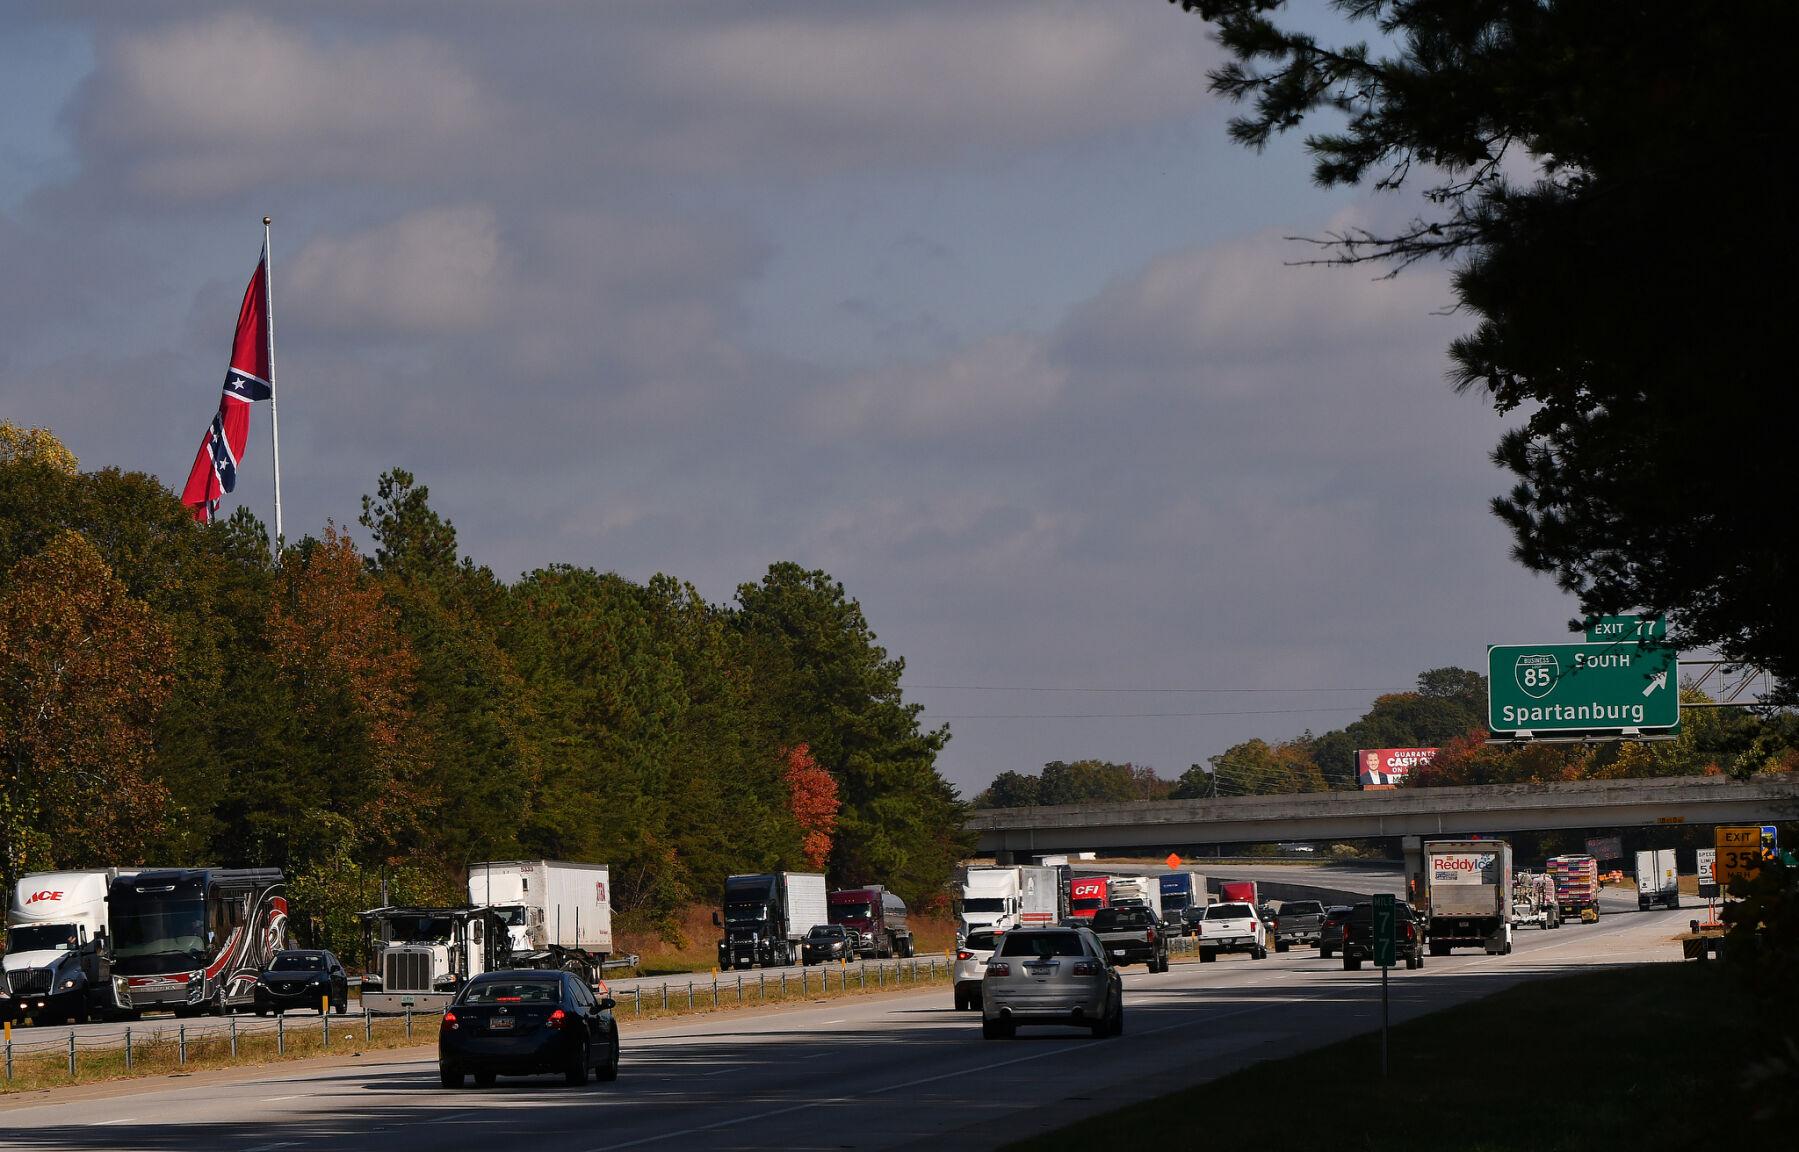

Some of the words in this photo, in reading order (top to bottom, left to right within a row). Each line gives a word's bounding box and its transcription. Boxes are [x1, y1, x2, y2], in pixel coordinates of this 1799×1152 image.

[1595, 623, 1624, 634] EXIT
[1634, 621, 1656, 635] 77
[1574, 653, 1630, 668] SOUTH
[1525, 668, 1550, 687] 85
[1503, 702, 1644, 726] Spartanburg
[1387, 757, 1417, 767] CASH
[1725, 832, 1752, 842] EXIT
[1726, 852, 1752, 869] 35
[25, 890, 64, 904] ACE
[1075, 885, 1100, 895] CFI
[1374, 896, 1393, 906] MILE
[1379, 911, 1391, 934] 7
[1379, 938, 1390, 960] 7
